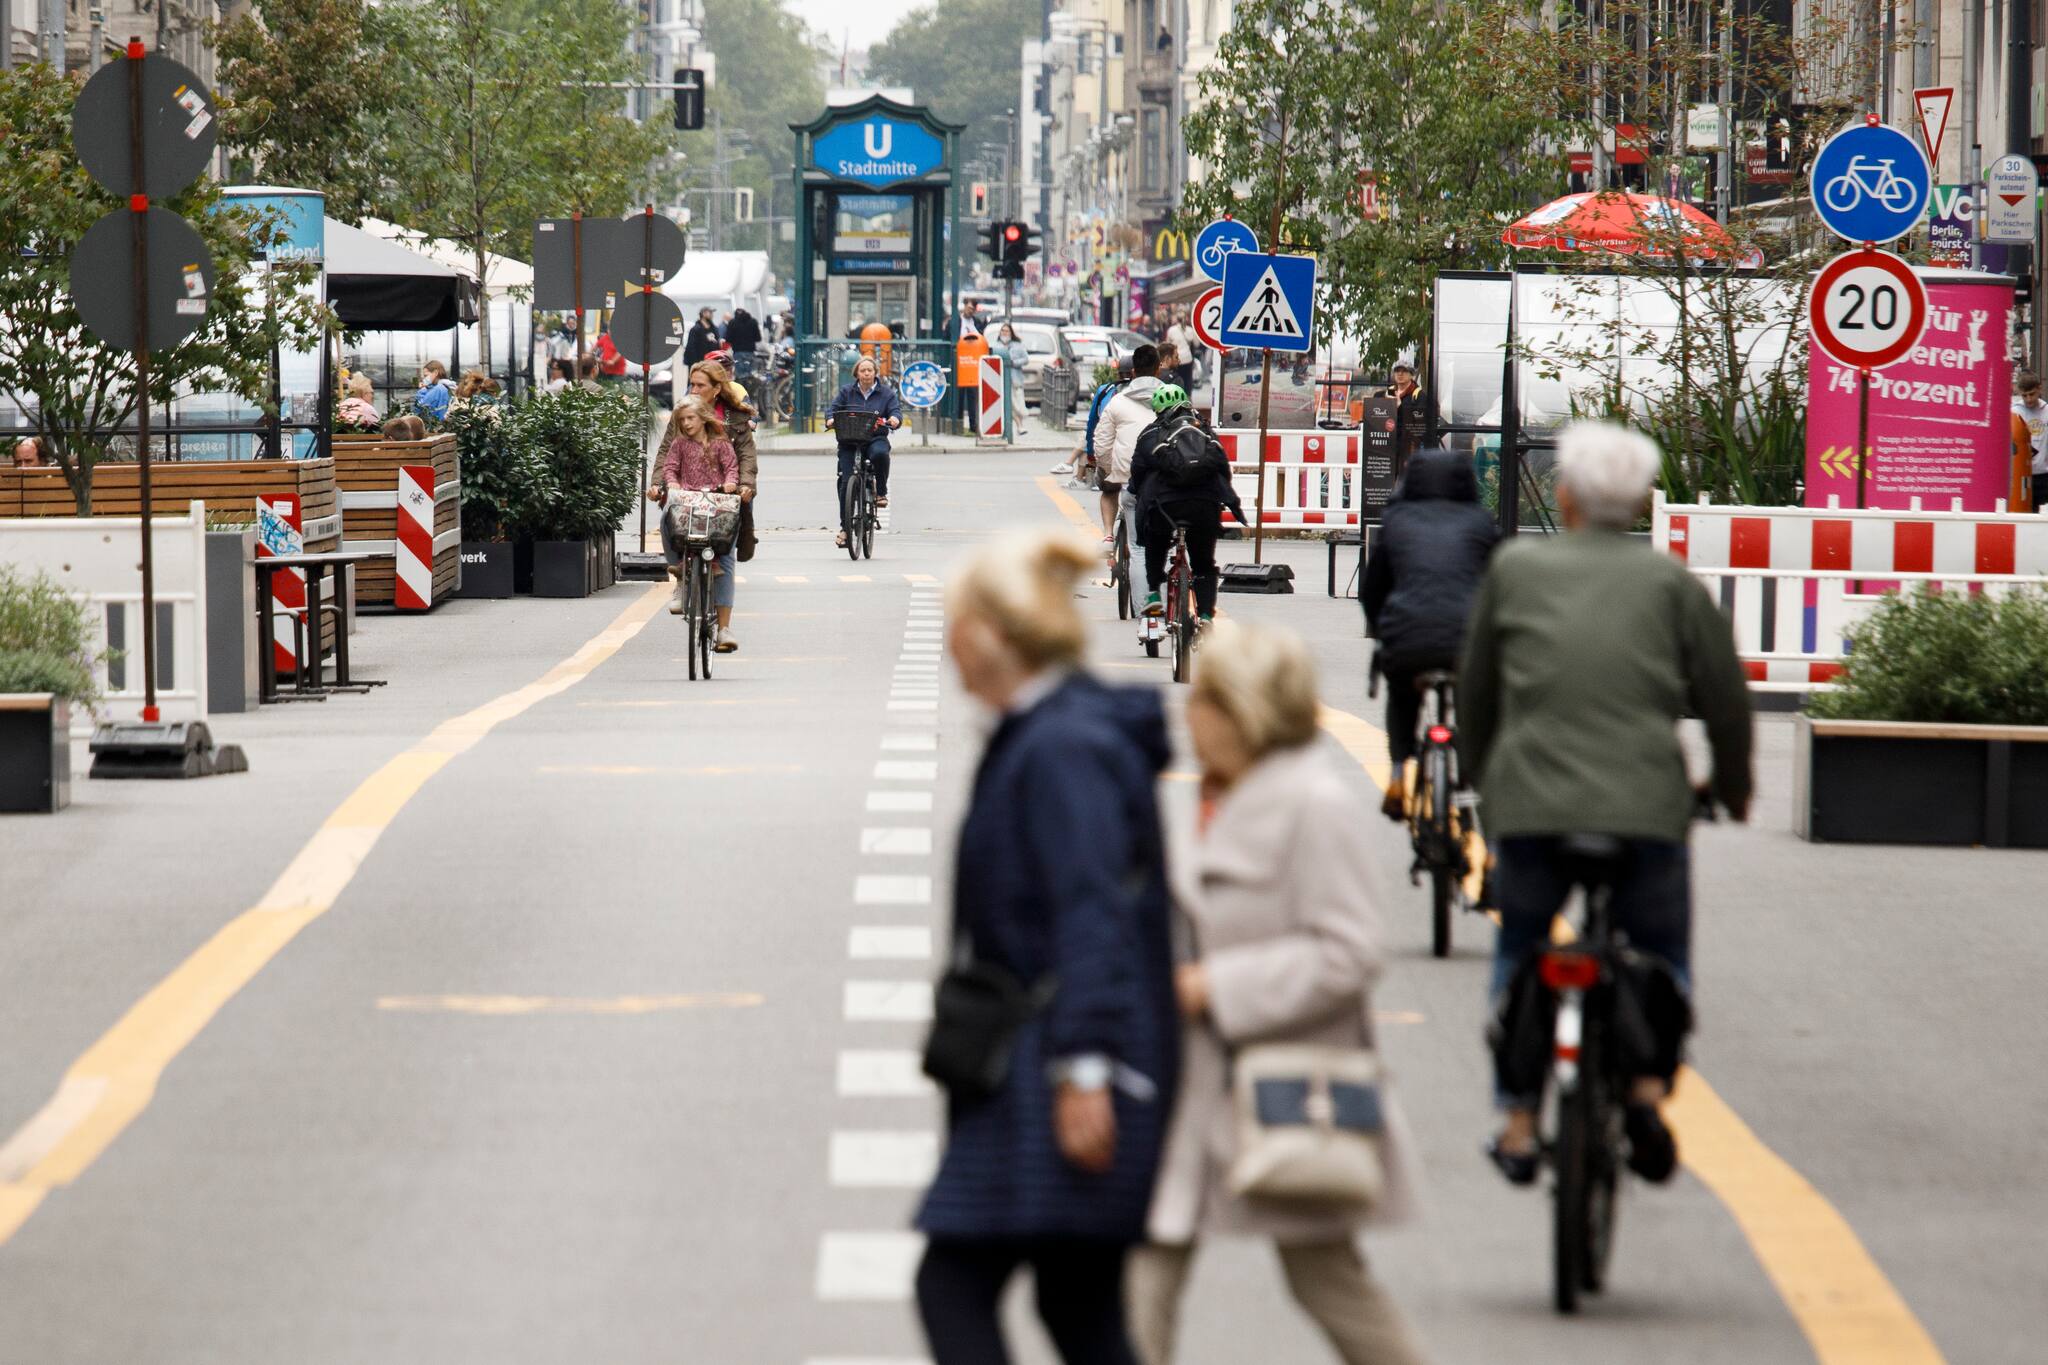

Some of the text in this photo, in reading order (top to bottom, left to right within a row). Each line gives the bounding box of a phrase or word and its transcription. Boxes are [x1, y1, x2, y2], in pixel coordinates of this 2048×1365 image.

[865, 123, 892, 159] U
[838, 160, 917, 176] Stadtmitte
[1994, 173, 2031, 182] Parkschein-
[2005, 161, 2020, 171] 30
[1991, 220, 2032, 228] Parkschein
[1208, 306, 1221, 330] 2
[1838, 284, 1898, 331] 20
[1926, 304, 1963, 332] für
[1827, 366, 1857, 394] 74
